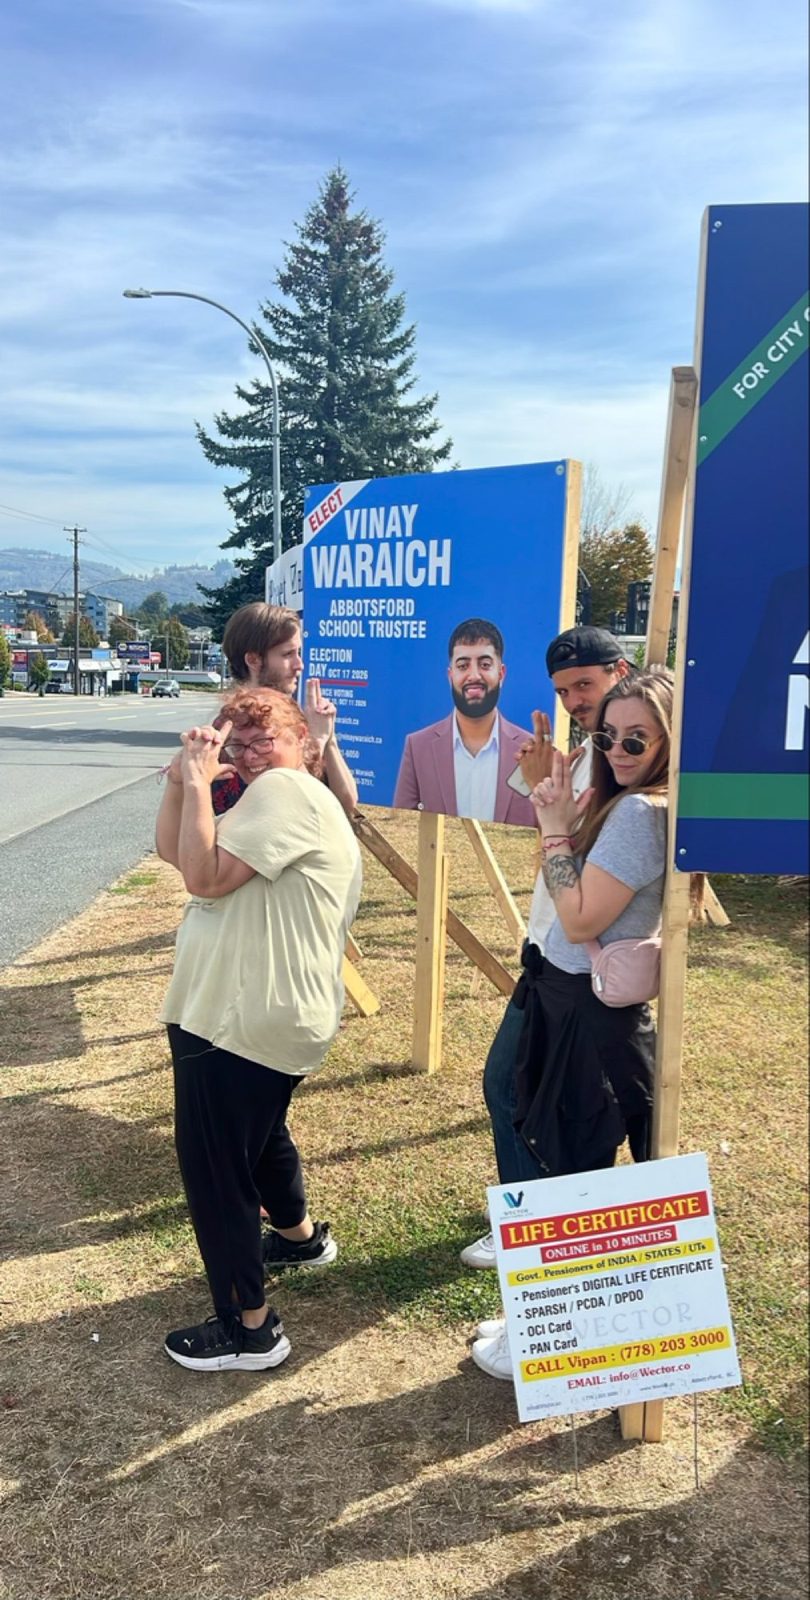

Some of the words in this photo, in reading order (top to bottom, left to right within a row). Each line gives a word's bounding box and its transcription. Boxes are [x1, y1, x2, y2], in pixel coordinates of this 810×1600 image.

[732, 362, 770, 398] FOR
[767, 320, 803, 362] CITY
[308, 488, 344, 532] ELECT
[344, 504, 418, 540] VINAY
[311, 538, 452, 588] WARAICH
[330, 598, 414, 617] ABBOTSFORD
[319, 620, 365, 638] SCHOOL
[368, 620, 426, 639] TRUSTEE
[309, 662, 327, 677] DAY
[328, 668, 340, 678] OCT
[342, 670, 350, 678] 17
[352, 670, 368, 679] 2026
[310, 648, 352, 662] ELECTION
[508, 1221, 557, 1244] LIFE
[562, 1197, 701, 1236] CERTIFICATE
[546, 1244, 590, 1259] ONLINE
[592, 1243, 602, 1251] in
[606, 1239, 619, 1248] 10
[621, 1229, 672, 1246] MINUTES
[516, 1272, 542, 1282] Govt.
[544, 1263, 593, 1277] Pensioners
[596, 1260, 606, 1268] of
[608, 1254, 637, 1266] INDIA
[645, 1246, 681, 1260] STATES
[522, 1284, 580, 1302] Pensioner's
[583, 1276, 622, 1292] DIGITAL
[625, 1270, 648, 1285] LIFE
[650, 1259, 713, 1280] CERTIFICATE
[525, 1303, 567, 1320] SPARSH
[576, 1297, 605, 1310] PCDA
[614, 1289, 644, 1304] DPDO
[528, 1325, 545, 1337] OCI
[548, 1320, 572, 1334] Card
[526, 1359, 564, 1375] CALL
[567, 1354, 607, 1369] Vipan
[620, 1343, 656, 1361] (778)
[660, 1338, 686, 1353] 203
[690, 1331, 724, 1348] 3000
[530, 1341, 551, 1354] PAN
[554, 1337, 578, 1350] Card
[567, 1376, 607, 1390] EMAIL:
[610, 1363, 691, 1382] info@Wector.co
